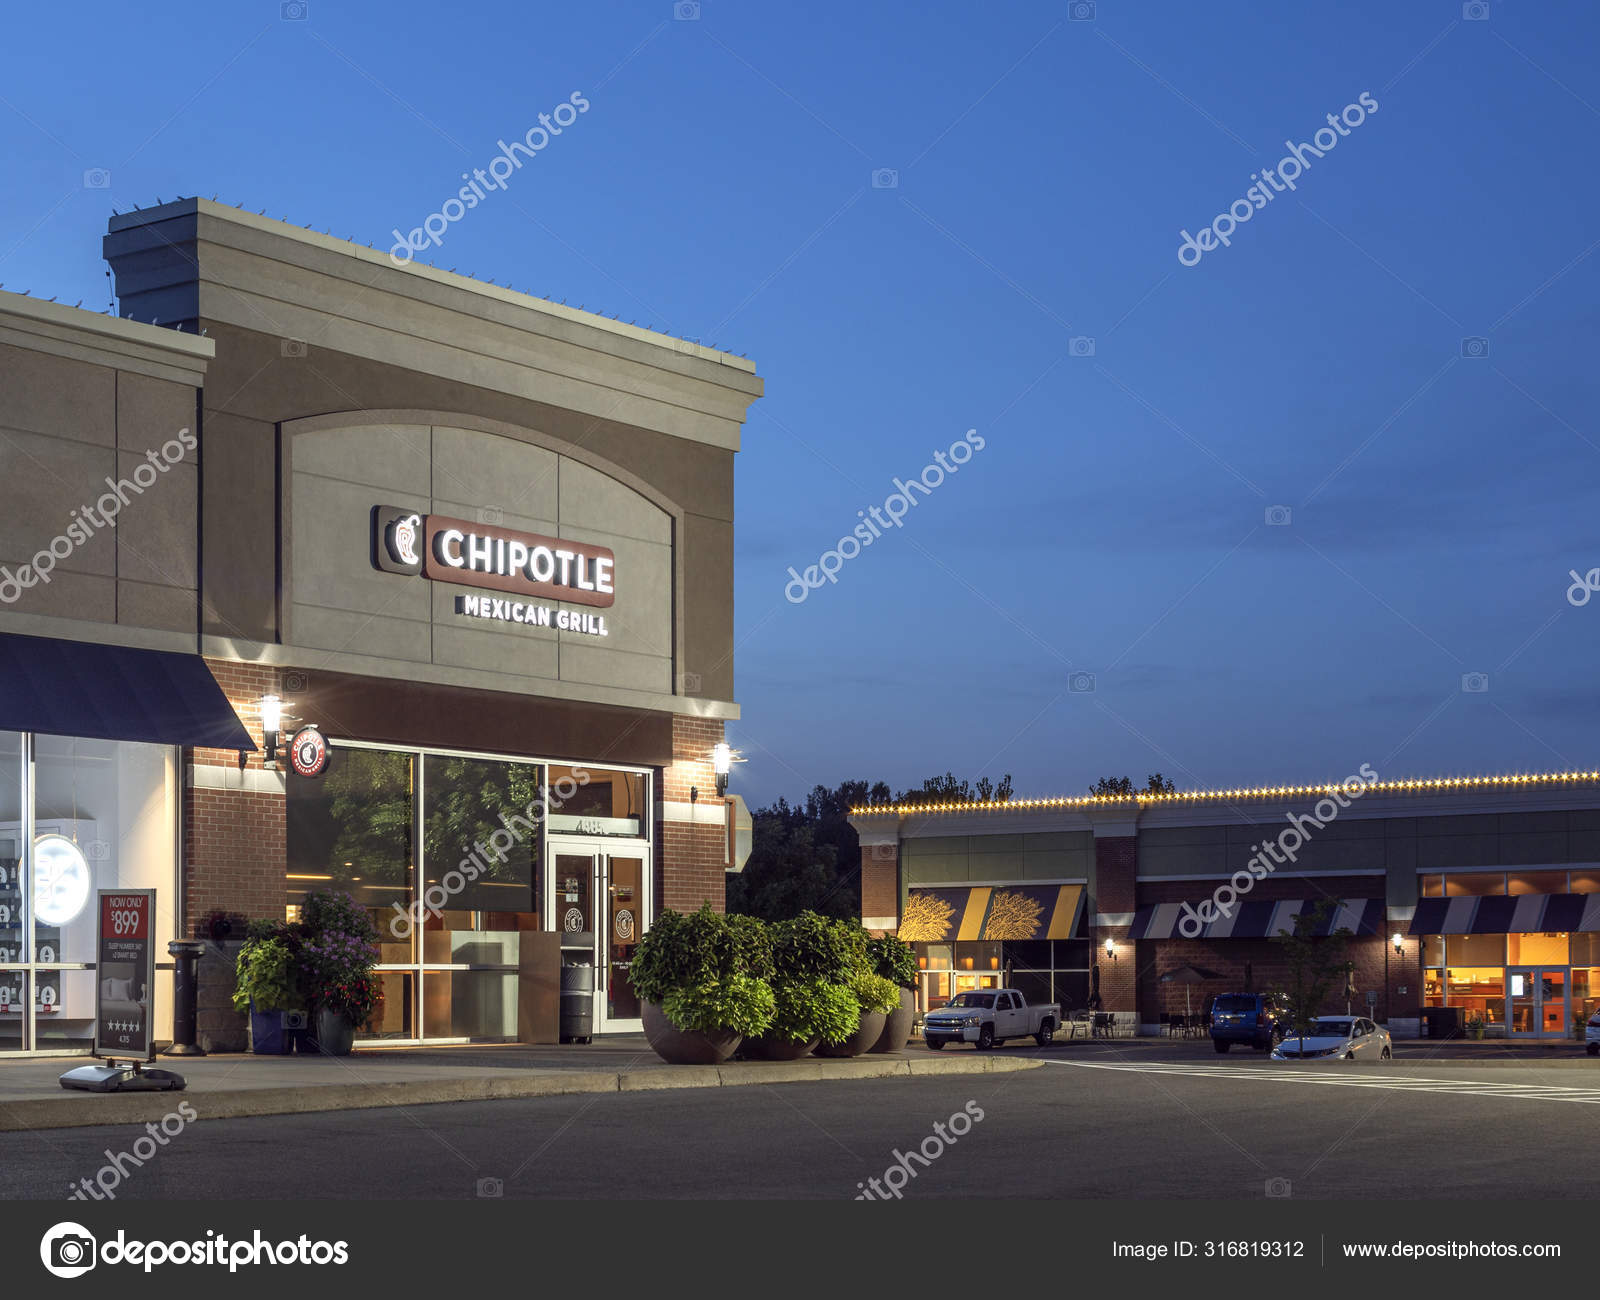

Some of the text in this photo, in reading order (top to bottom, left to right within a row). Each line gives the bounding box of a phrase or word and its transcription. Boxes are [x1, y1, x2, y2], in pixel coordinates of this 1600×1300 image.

[440, 529, 614, 594] CHIPOTLE
[463, 595, 608, 636] MEXICAN GRILL
[294, 734, 323, 751] CHIPOTLE
[109, 896, 143, 908] NOW ONLY
[111, 910, 139, 934] $899
